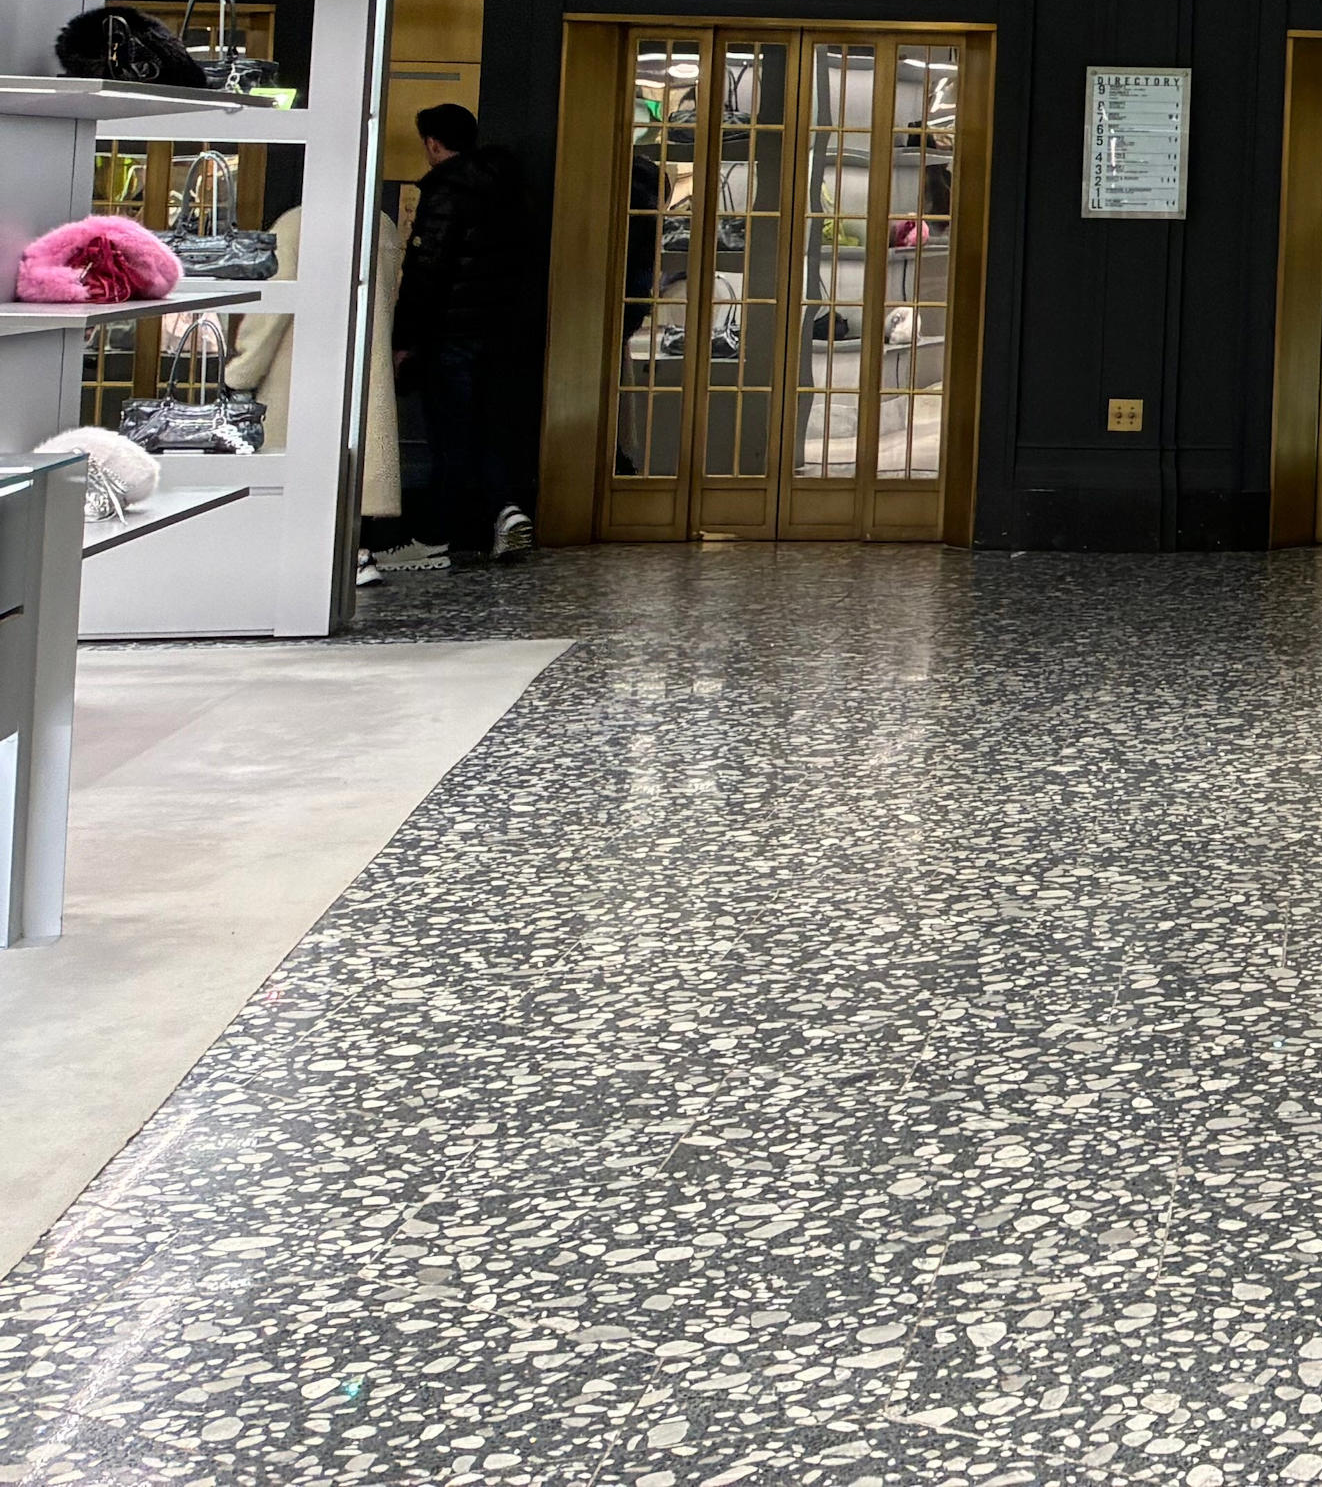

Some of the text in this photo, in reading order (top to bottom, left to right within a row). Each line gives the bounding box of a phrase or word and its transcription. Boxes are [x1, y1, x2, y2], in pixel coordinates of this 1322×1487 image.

[1097, 76, 1180, 87] DIRECTORY
[1099, 84, 1106, 95] 9
[1097, 124, 1104, 134] 6
[1096, 136, 1104, 146] 5
[1095, 153, 1103, 162] 4
[1095, 164, 1102, 175] 3
[1094, 176, 1101, 186] 2
[1092, 199, 1103, 209] LL
